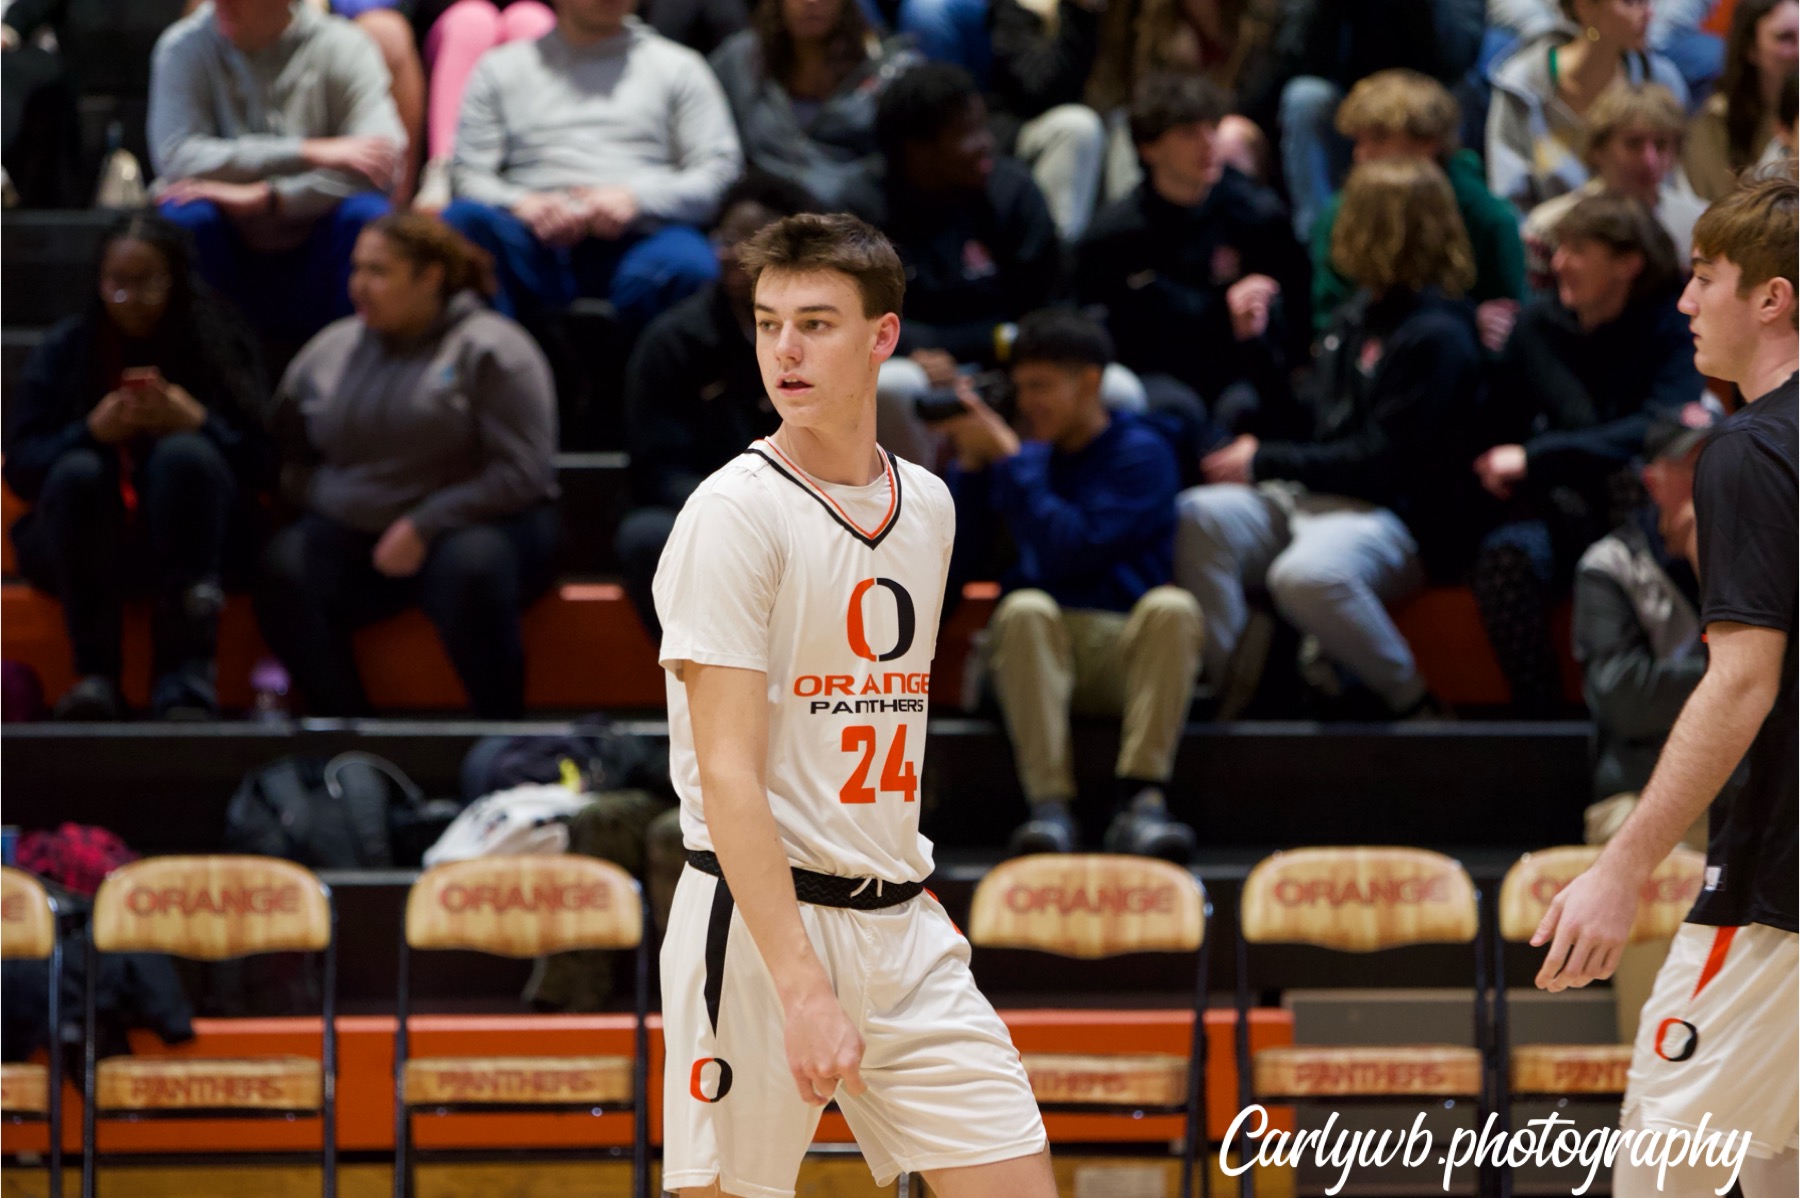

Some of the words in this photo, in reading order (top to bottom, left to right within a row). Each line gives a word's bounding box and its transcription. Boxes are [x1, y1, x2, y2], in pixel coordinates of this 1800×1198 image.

[847, 577, 916, 662] O
[793, 672, 930, 697] ORANGE
[810, 698, 924, 715] PANTHERS
[839, 723, 917, 804] 24
[127, 885, 301, 917] ORANGE
[438, 883, 610, 914] ORANGE
[1004, 884, 1175, 916] ORANGE
[1274, 876, 1451, 907] ORANGE
[1654, 1017, 1698, 1062] O
[689, 1057, 733, 1103] O
